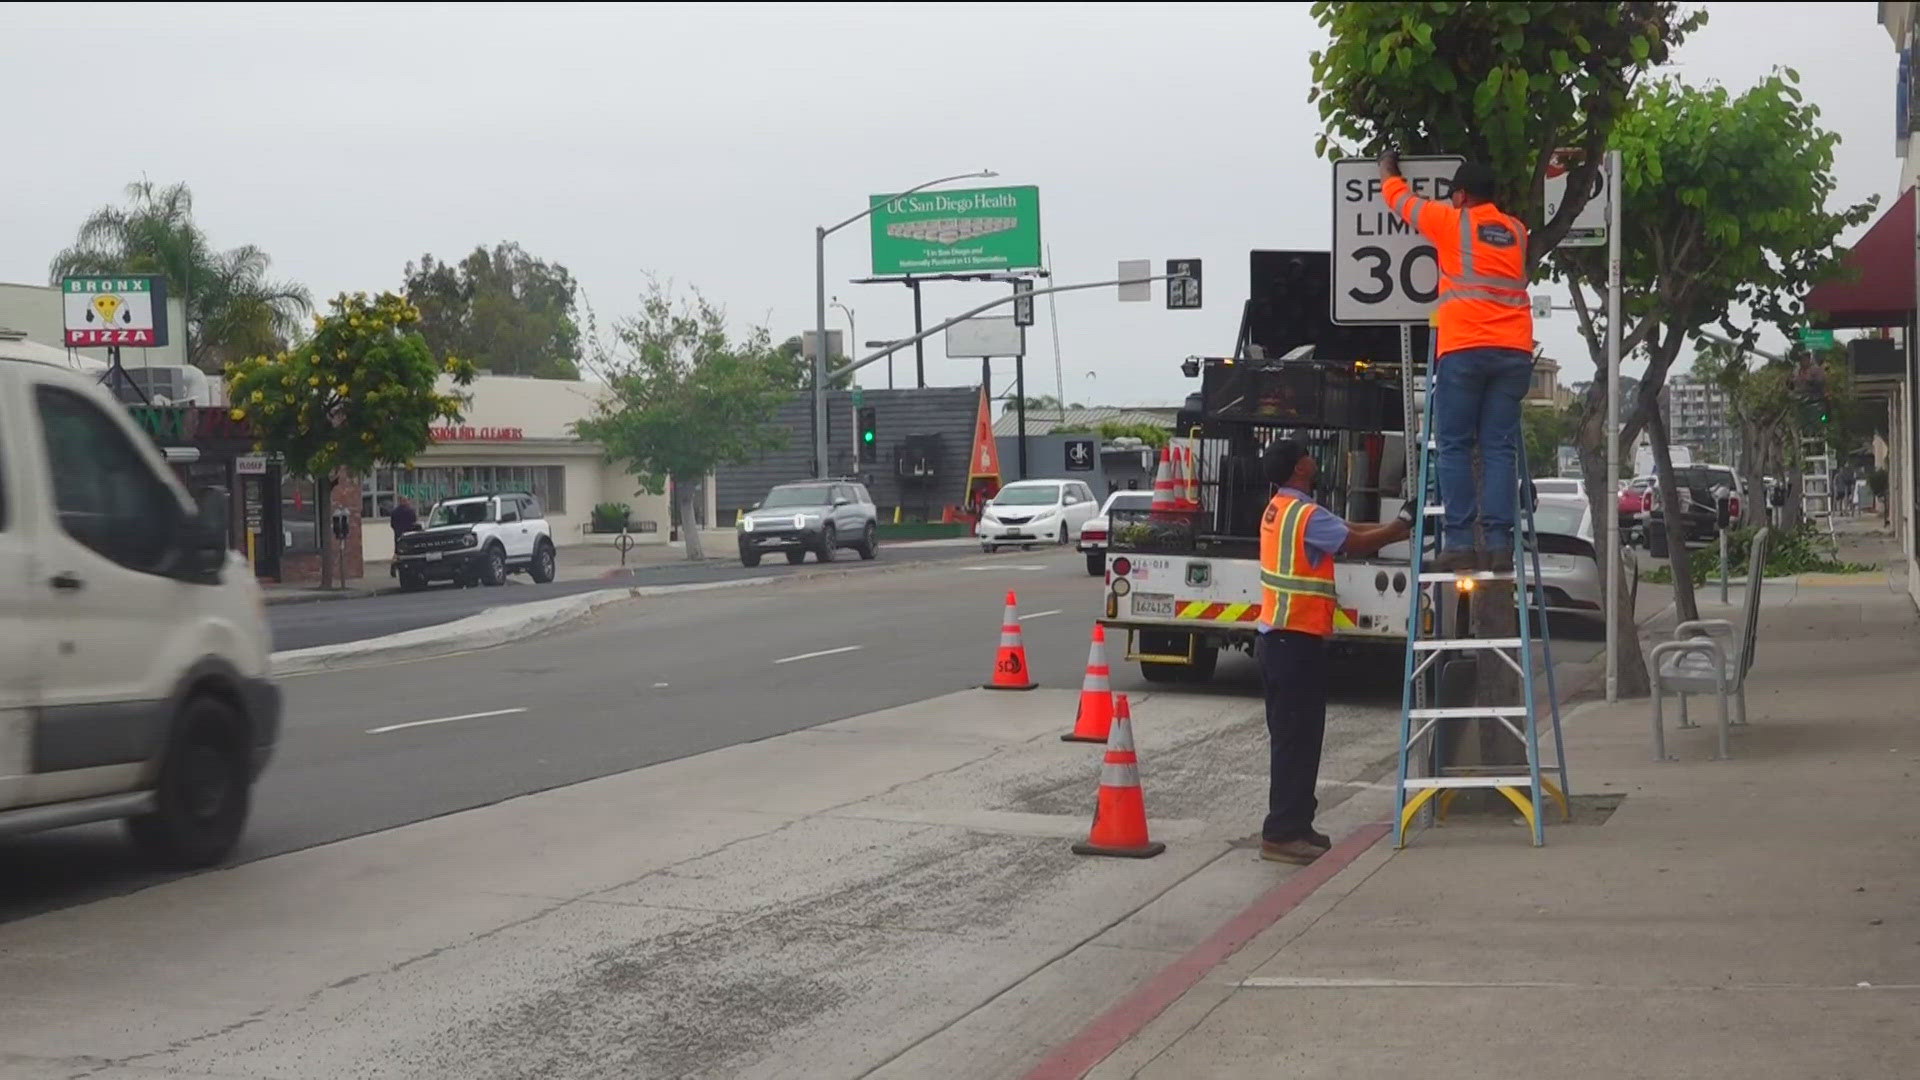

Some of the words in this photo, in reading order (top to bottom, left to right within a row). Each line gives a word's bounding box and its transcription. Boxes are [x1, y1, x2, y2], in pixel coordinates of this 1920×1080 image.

[1345, 176, 1452, 202] SPED
[887, 199, 907, 214] UC
[909, 197, 934, 213] San
[936, 196, 973, 213] Diego
[974, 193, 1017, 209] Health
[1547, 203, 1555, 216] 3
[1356, 212, 1420, 236] LIM
[1348, 245, 1440, 304] 30
[71, 281, 143, 292] BRONX
[71, 331, 147, 342] PIZZA
[481, 427, 522, 440] CLEANERS
